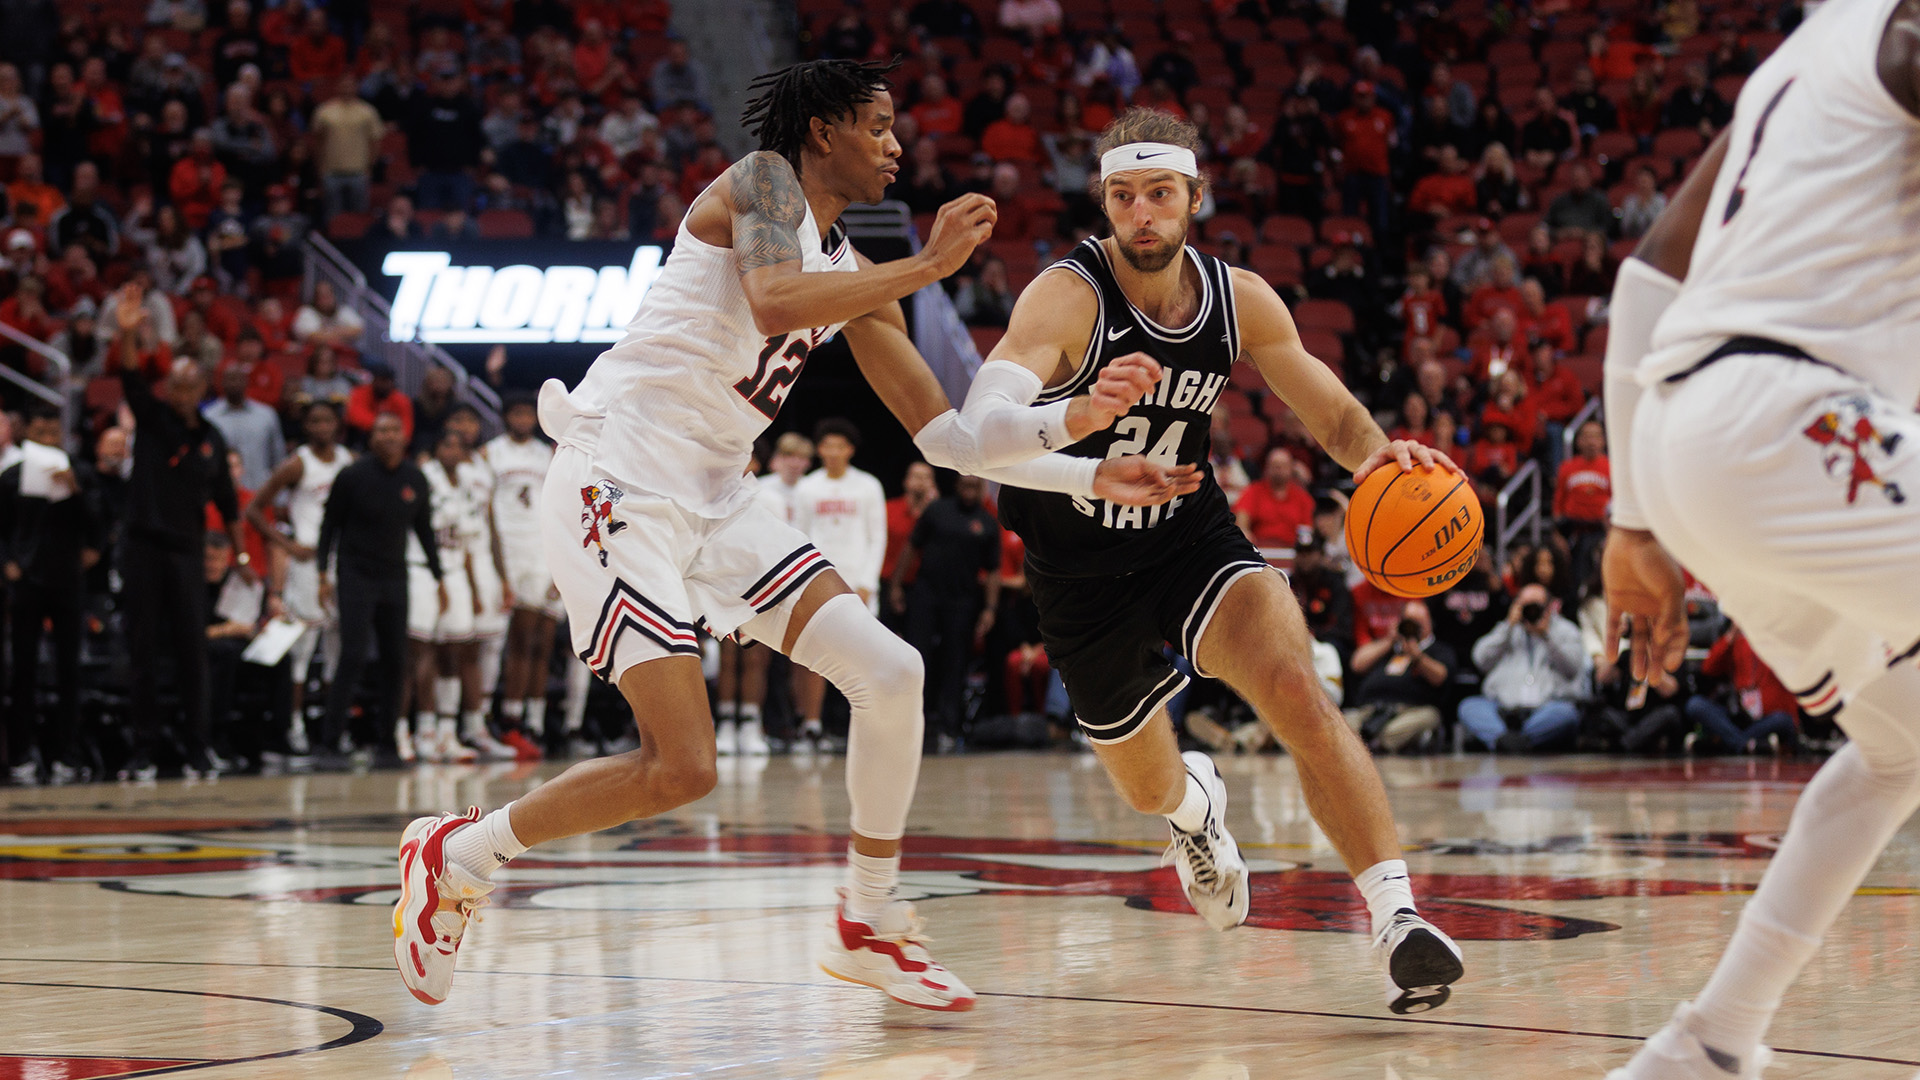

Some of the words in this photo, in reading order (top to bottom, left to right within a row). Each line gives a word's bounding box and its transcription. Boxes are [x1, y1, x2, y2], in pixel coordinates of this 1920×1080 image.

[381, 245, 664, 343] THORN
[733, 332, 809, 421] 12
[1088, 366, 1229, 415] IGH
[1105, 416, 1188, 467] 24
[1434, 505, 1471, 550] EVO
